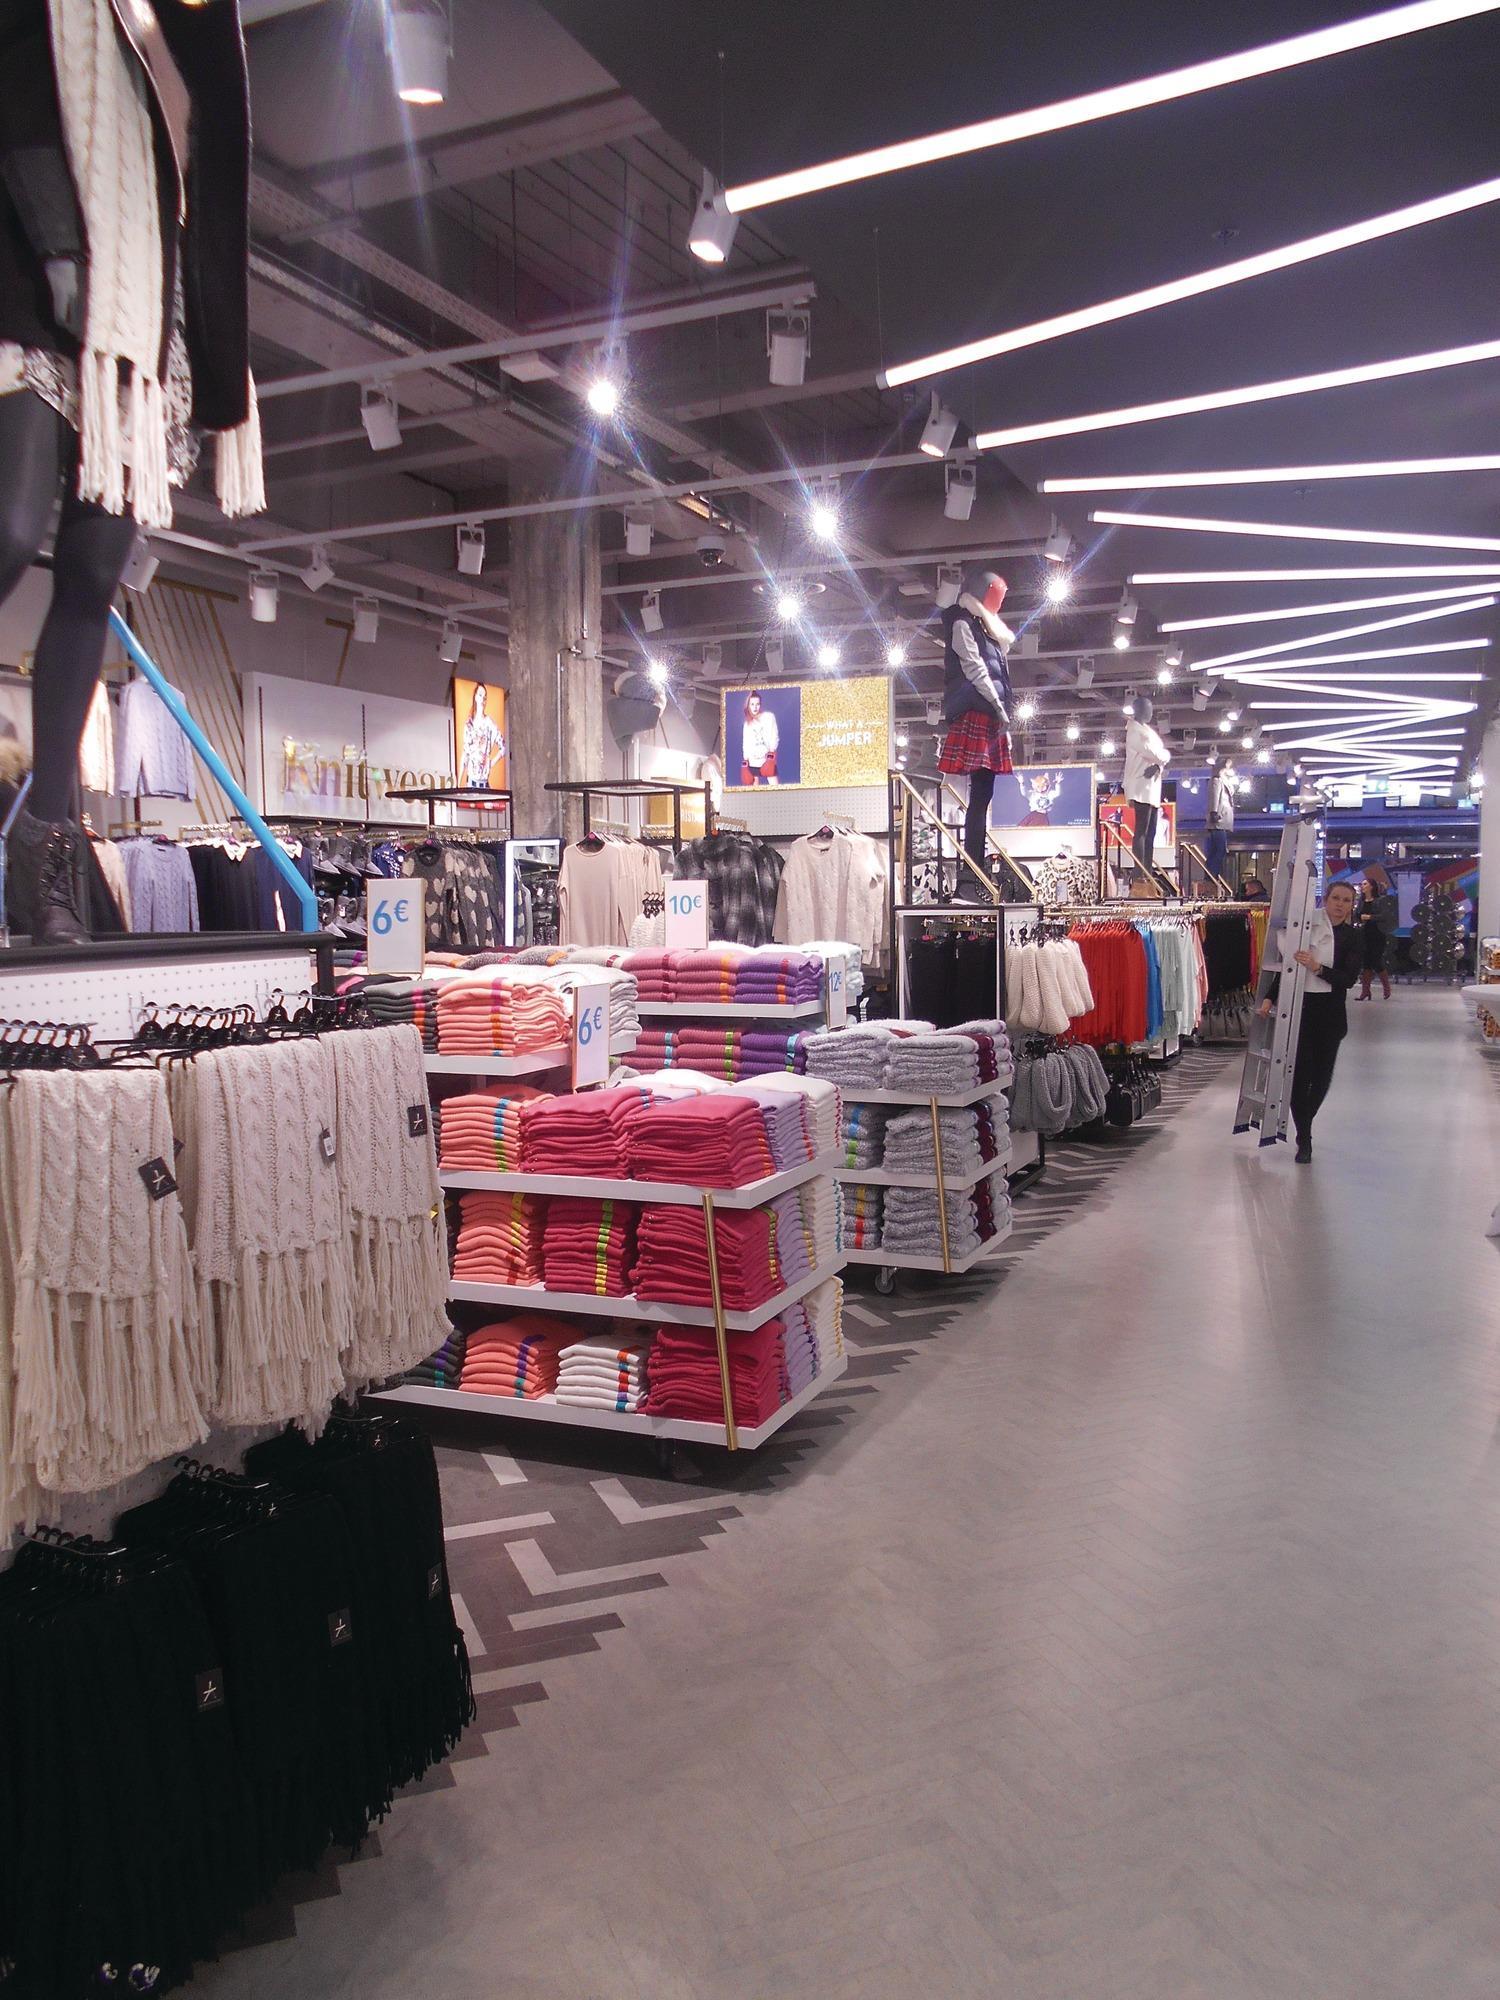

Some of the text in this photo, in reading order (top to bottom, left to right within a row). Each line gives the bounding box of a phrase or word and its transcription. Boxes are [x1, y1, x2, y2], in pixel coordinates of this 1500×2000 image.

[817, 731, 873, 748] JUMPER
[281, 733, 455, 806] Knitwear
[372, 899, 409, 935] 6€
[668, 894, 702, 916] 10€
[578, 1006, 604, 1046] 6€
